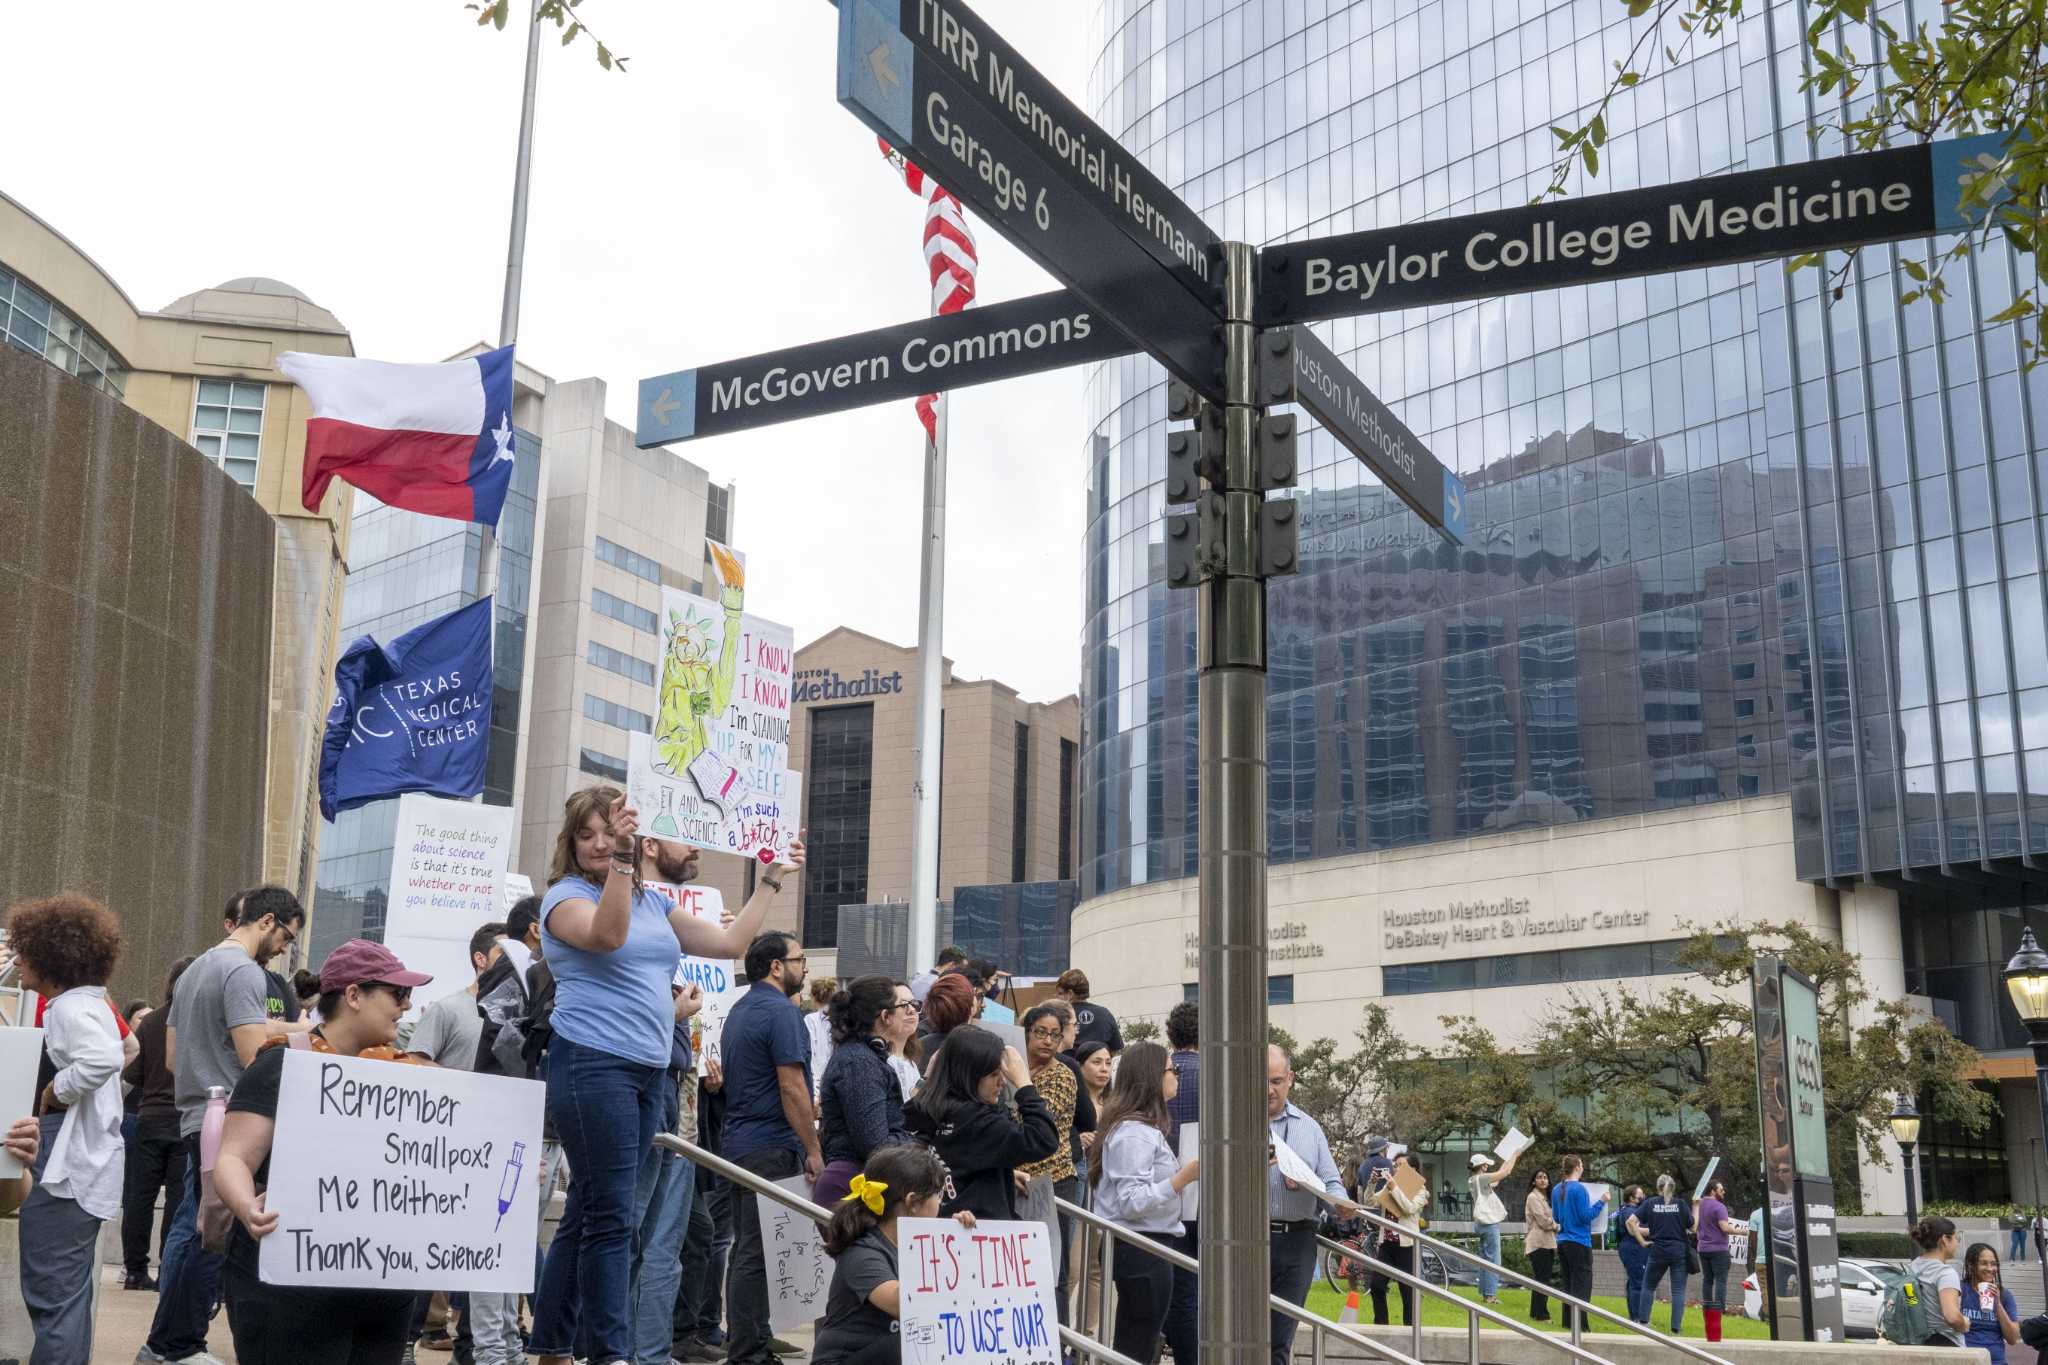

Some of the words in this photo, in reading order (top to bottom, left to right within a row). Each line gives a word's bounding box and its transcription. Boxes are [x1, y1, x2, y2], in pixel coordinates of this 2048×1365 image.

[919, 0, 979, 83] TIRR
[989, 52, 1106, 192] Memorial
[1114, 163, 1208, 283] Hermann
[926, 91, 1027, 210] Garage
[1036, 187, 1050, 231] 6
[1305, 243, 1448, 300] Baylor
[1463, 220, 1651, 266] College
[1669, 181, 1912, 245] Medicine
[711, 353, 889, 413] McGovern
[902, 312, 1091, 373] Commons
[1296, 346, 1341, 408] uston
[1347, 386, 1416, 480] Methodist
[744, 633, 751, 663] I
[758, 639, 790, 675] KNOW
[394, 671, 461, 701] TEXAS
[741, 674, 748, 699] I
[754, 675, 787, 710] KNOW
[791, 668, 902, 703] Methodist
[418, 720, 478, 747] CENTER
[730, 705, 748, 731] I'm
[752, 712, 790, 745] STANDING
[740, 741, 753, 762] FOR
[759, 743, 777, 769] MY
[748, 767, 781, 795] SELF
[680, 794, 699, 815] AND
[736, 804, 752, 822] I'm
[755, 801, 780, 818] such
[412, 840, 445, 856] about
[448, 846, 485, 860] science
[416, 824, 436, 838] The
[439, 829, 466, 842] good
[470, 831, 498, 848] thing
[728, 830, 737, 847] a
[411, 857, 420, 870] is
[423, 860, 448, 873] that
[451, 861, 467, 875] it's
[471, 864, 493, 878] true
[405, 895, 426, 908] you
[431, 893, 466, 909] believe
[470, 897, 480, 911] in
[484, 898, 493, 912] it
[408, 876, 457, 891] whether
[458, 883, 471, 893] or
[474, 884, 493, 895] not
[1384, 907, 1445, 928] Houston
[1449, 897, 1531, 920] Methodist
[1384, 929, 1448, 949] DeBakey
[1452, 922, 1497, 943] Heart
[1501, 919, 1515, 938] &
[1518, 912, 1587, 936] Vascular
[1591, 909, 1650, 929] Center
[1266, 943, 1324, 961] nstitute
[680, 963, 726, 992] WARD
[320, 1063, 462, 1127] Remember
[384, 1132, 493, 1174] Smallpox?
[318, 1175, 359, 1213] Me
[774, 1212, 791, 1241] The
[286, 1228, 373, 1273] Thank
[376, 1244, 419, 1279] you,
[426, 1242, 502, 1272] Science!
[812, 1223, 825, 1289] ience
[971, 1233, 1036, 1288] TIME
[776, 1248, 794, 1300] People
[939, 1312, 965, 1356] TO
[970, 1307, 1008, 1354] USE
[1012, 1303, 1048, 1348] OUR
